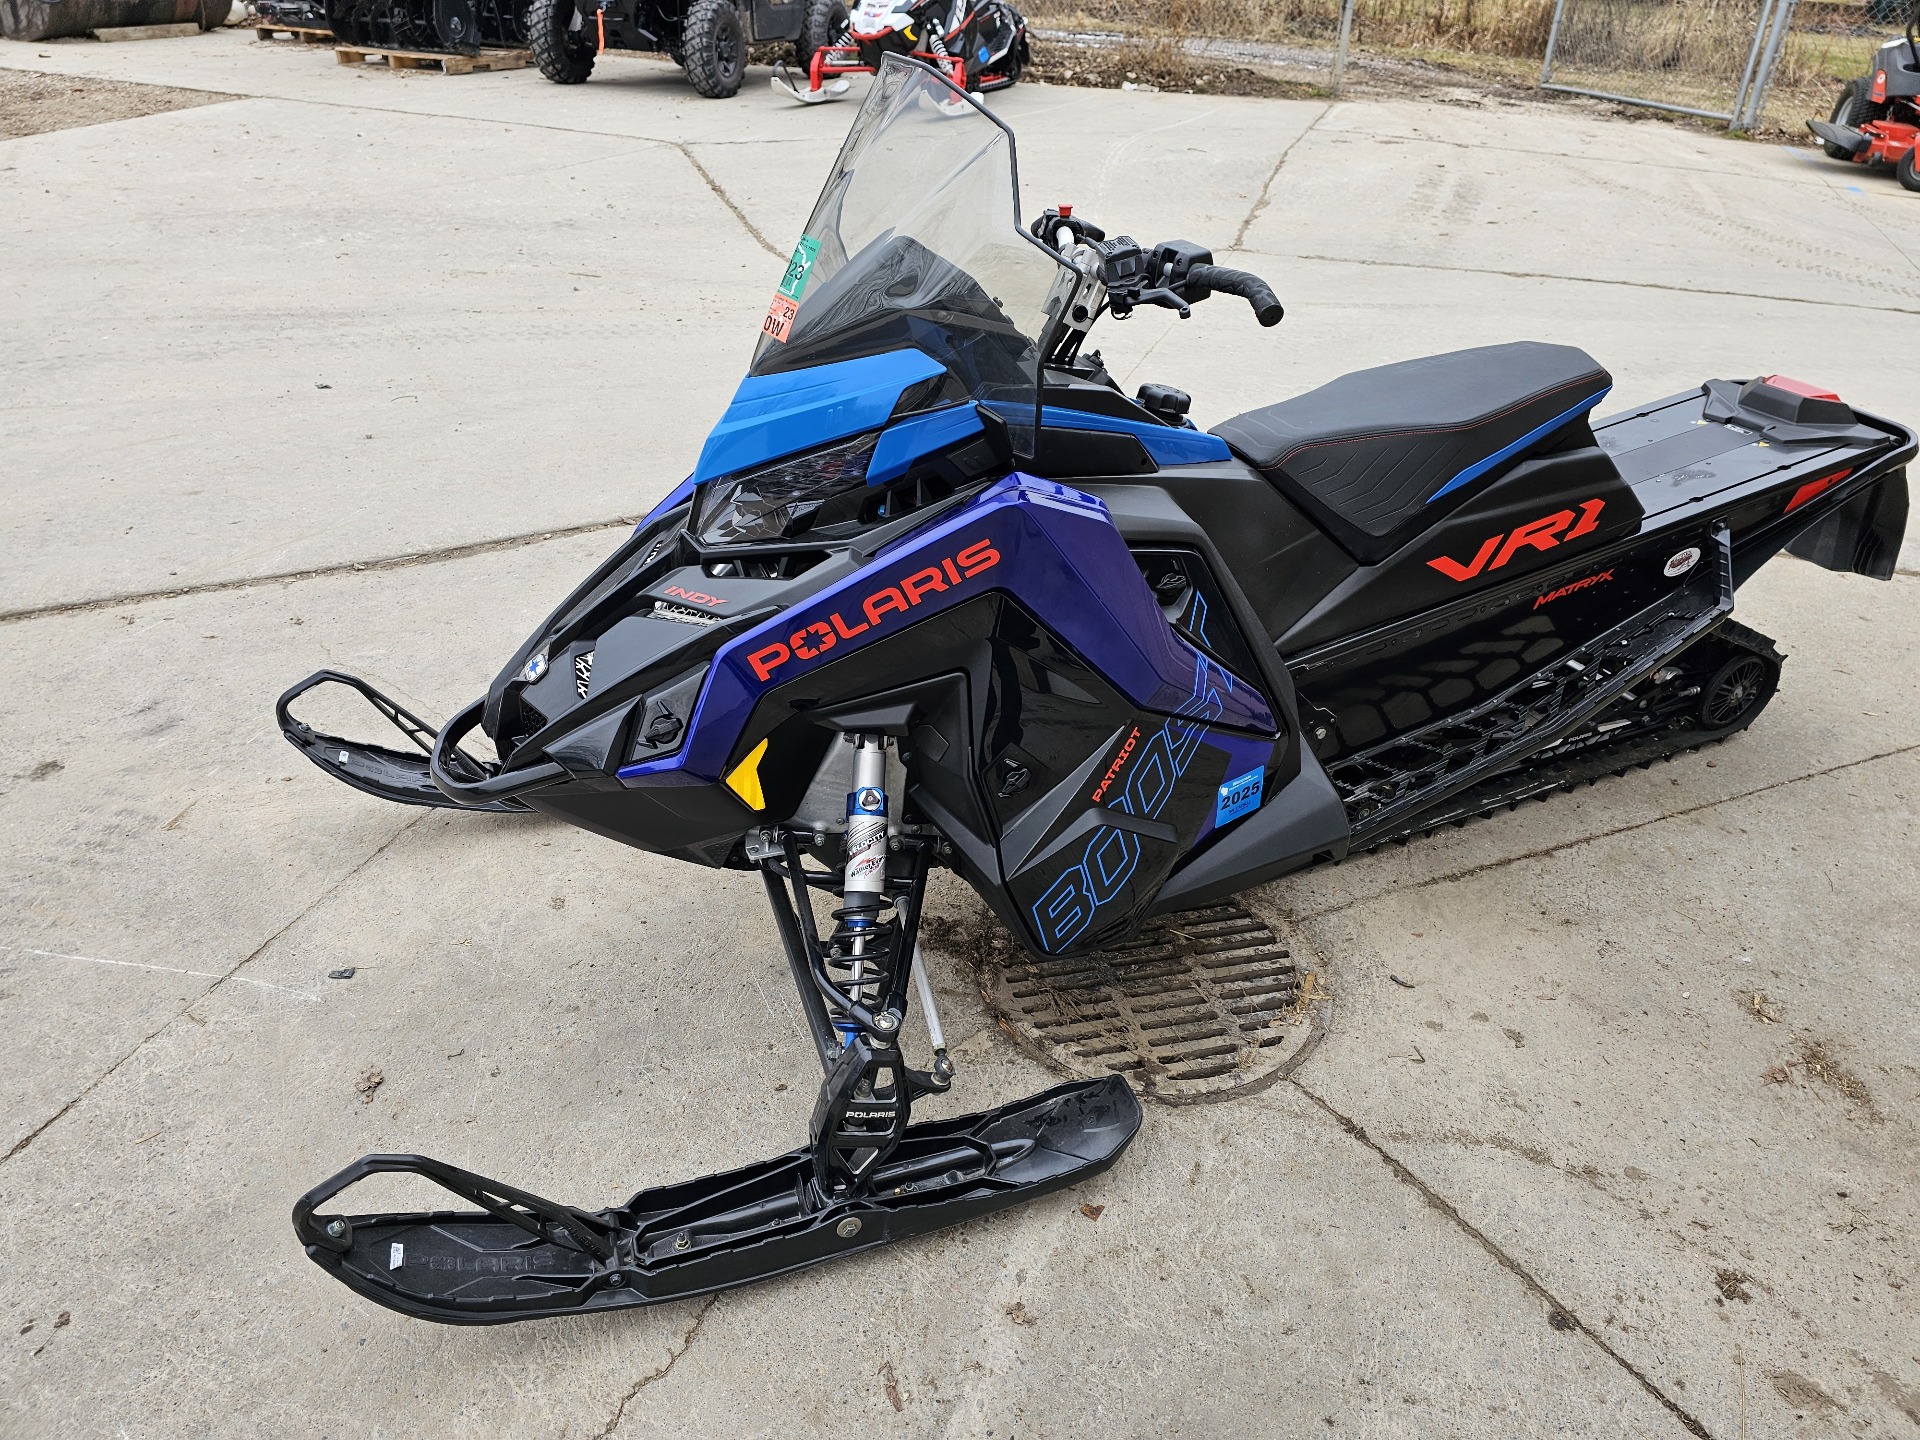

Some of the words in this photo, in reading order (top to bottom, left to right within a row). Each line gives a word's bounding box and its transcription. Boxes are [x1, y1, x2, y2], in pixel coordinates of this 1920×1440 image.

[783, 306, 795, 320] 23
[1426, 498, 1606, 582] VR1
[663, 584, 731, 607] INDY
[1532, 568, 1615, 611] MATRYX
[746, 538, 1001, 682] POLARIS
[1092, 726, 1141, 803] PATRIOT
[1220, 780, 1260, 811] 2025
[845, 1110, 897, 1118] POLARIS
[403, 1250, 556, 1272] POLARIS
